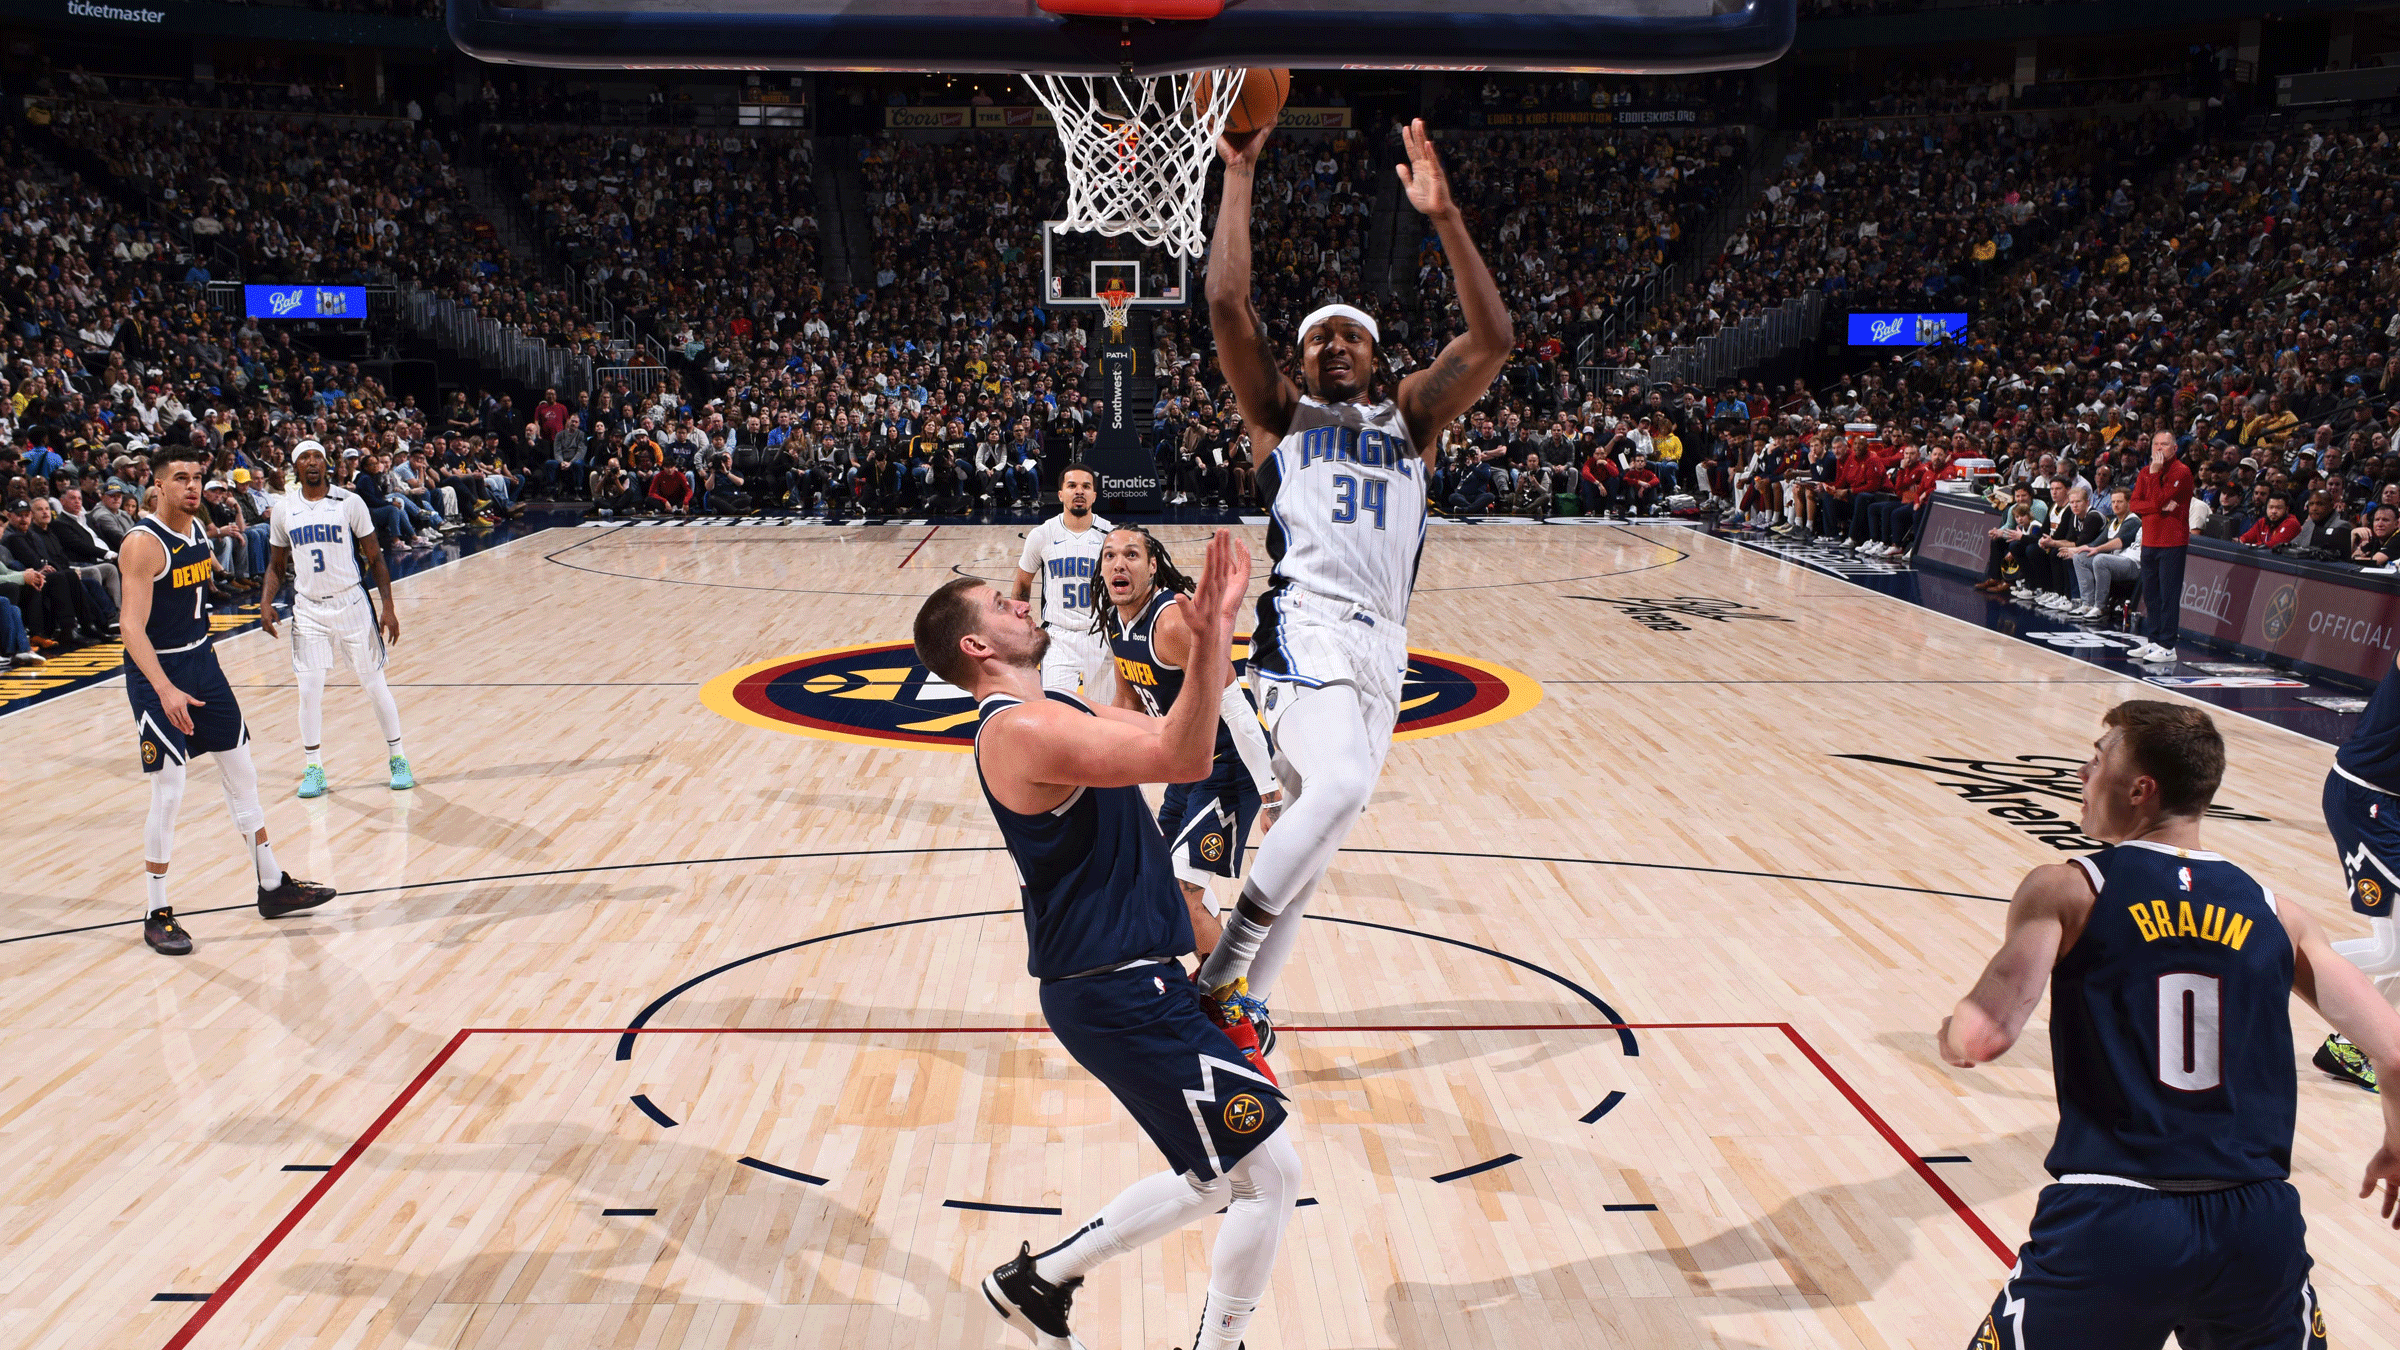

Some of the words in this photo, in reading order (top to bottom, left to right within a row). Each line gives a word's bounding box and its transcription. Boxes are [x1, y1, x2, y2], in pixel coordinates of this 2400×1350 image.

[67, 0, 165, 22] ticketmaster
[891, 108, 940, 126] Coors
[978, 113, 1001, 122] THE
[1276, 108, 1321, 126] Coors
[1526, 113, 1548, 124] KIDS
[1551, 112, 1612, 124] FOUNDATION
[1619, 111, 1696, 123] EDDIESKIDS.ORG
[269, 289, 303, 315] Ball
[1871, 317, 1904, 342] Ball
[1112, 370, 1122, 429] Southwest
[1300, 424, 1412, 480] MAGIC
[1102, 475, 1156, 488] Fanatics
[1102, 490, 1148, 499] Sportsbook
[1331, 473, 1389, 531] 34
[289, 524, 343, 549] MAGIC
[1933, 517, 1985, 557] uchealth
[172, 557, 212, 589] DENVE
[310, 548, 326, 573] 3
[1047, 556, 1096, 580] MAGI
[194, 586, 203, 619] 1
[1062, 582, 1091, 609] 50
[1612, 605, 1693, 632] Arena
[2308, 610, 2392, 651] OFFICIAL
[2127, 900, 2254, 951] BRAUN
[2157, 970, 2223, 1094] 0
